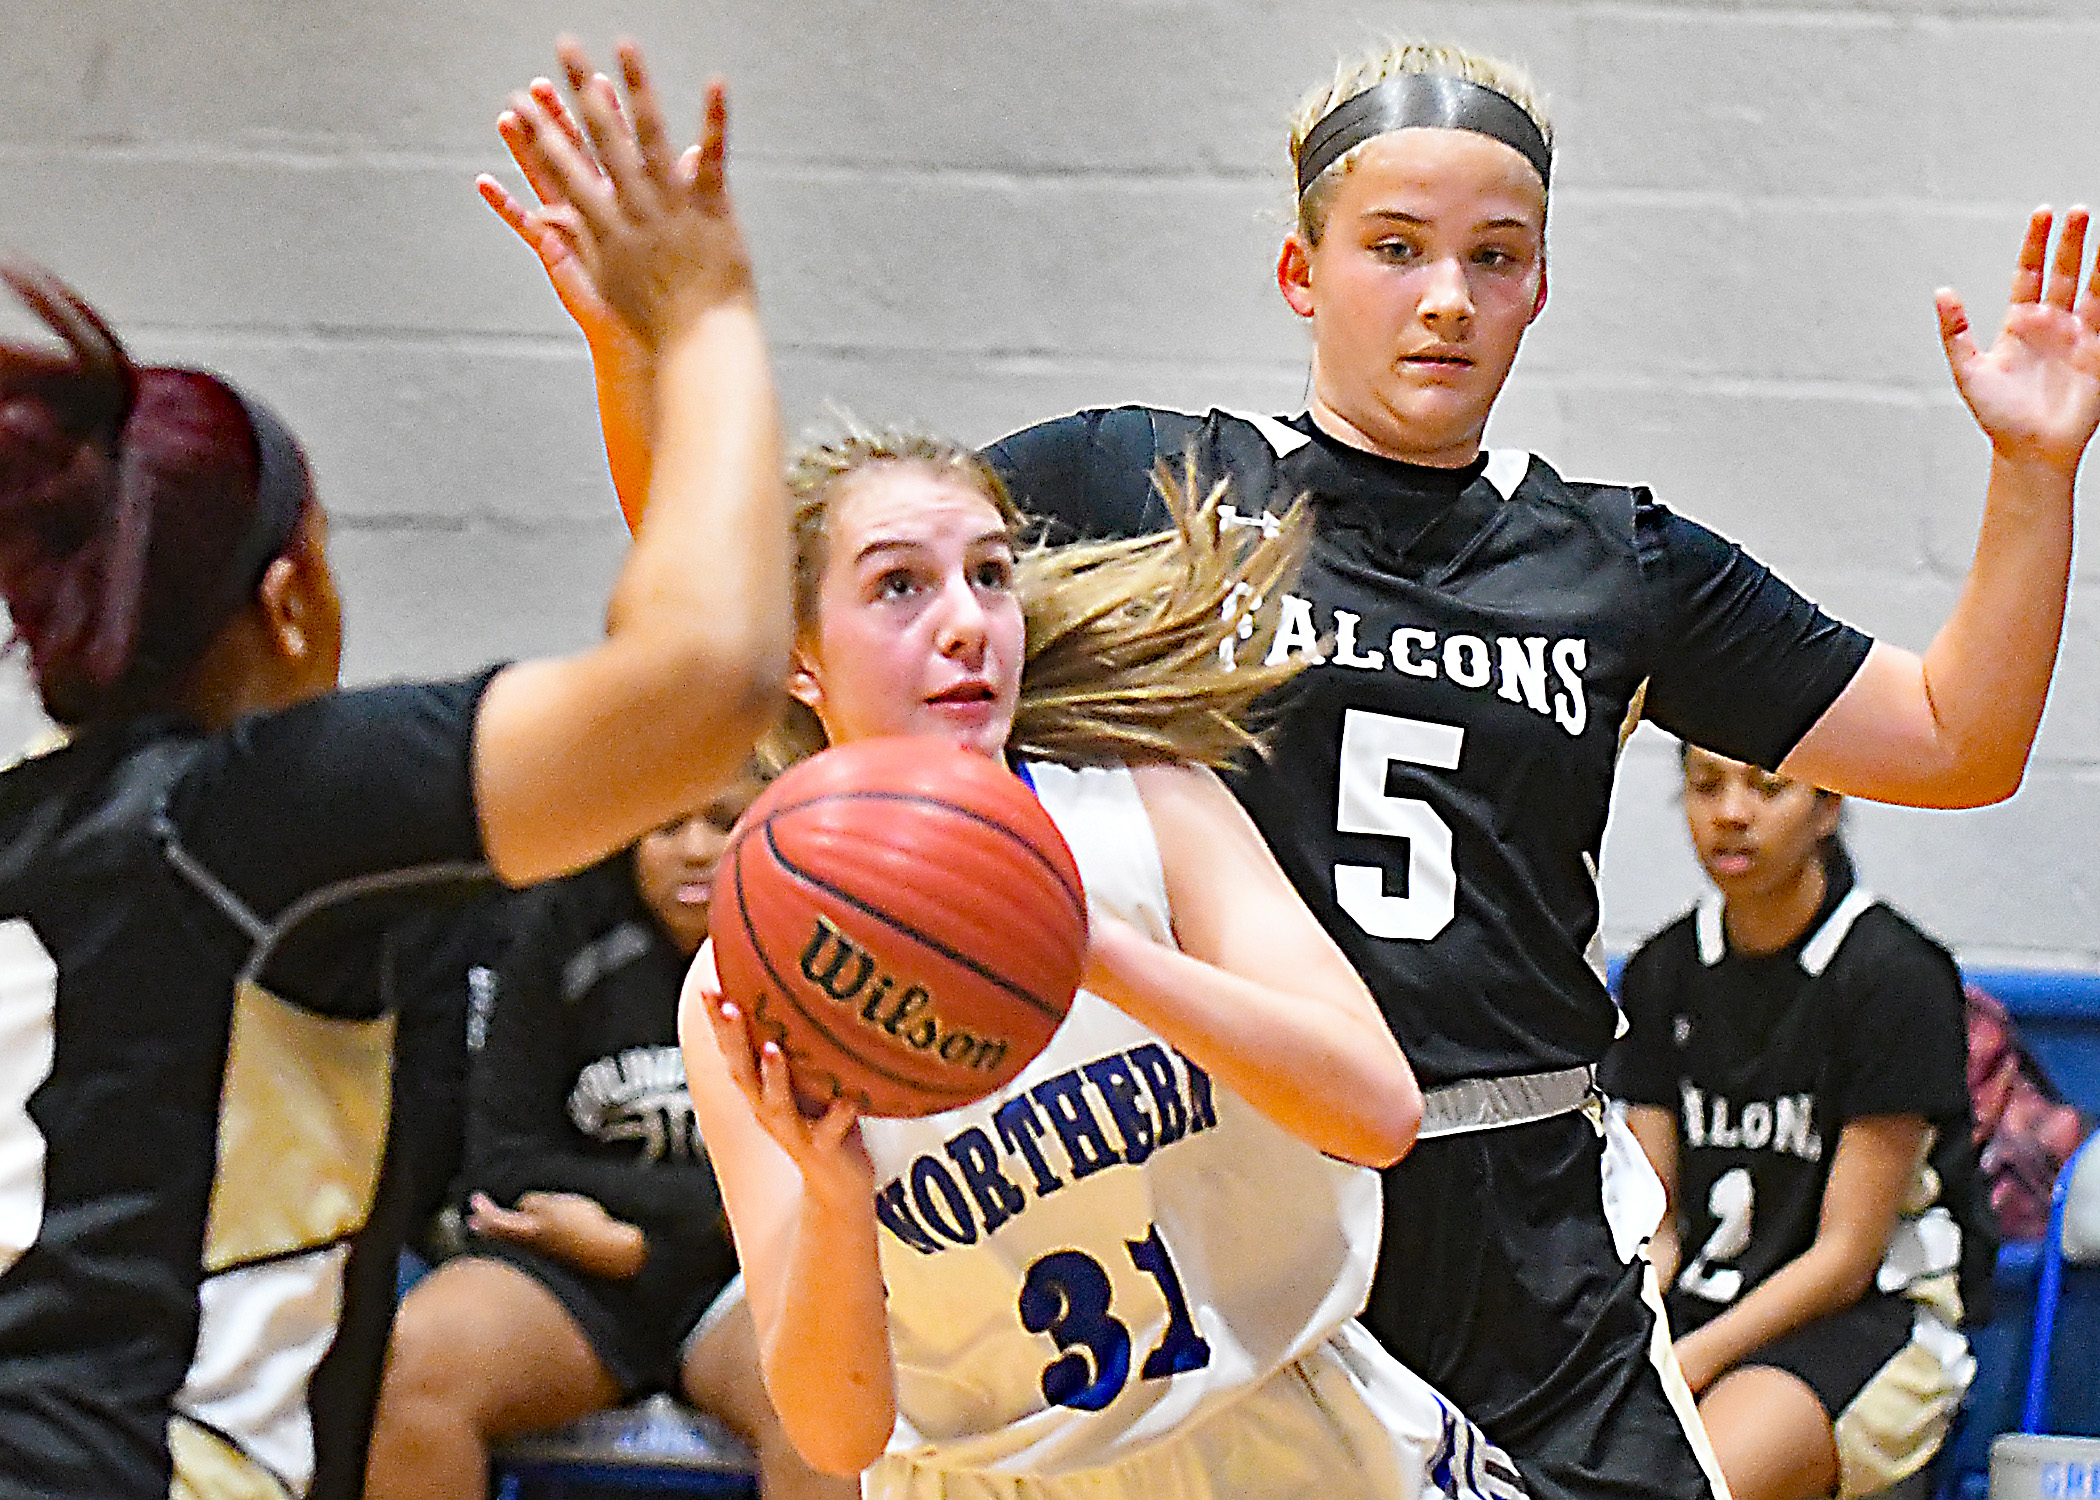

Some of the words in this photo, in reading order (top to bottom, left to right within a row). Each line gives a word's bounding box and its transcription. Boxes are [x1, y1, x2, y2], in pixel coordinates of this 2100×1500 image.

[1334, 708, 1465, 941] 5
[800, 913, 1009, 1073] Wilson
[1018, 1223, 1212, 1412] 31
[1679, 1167, 1756, 1303] 2
